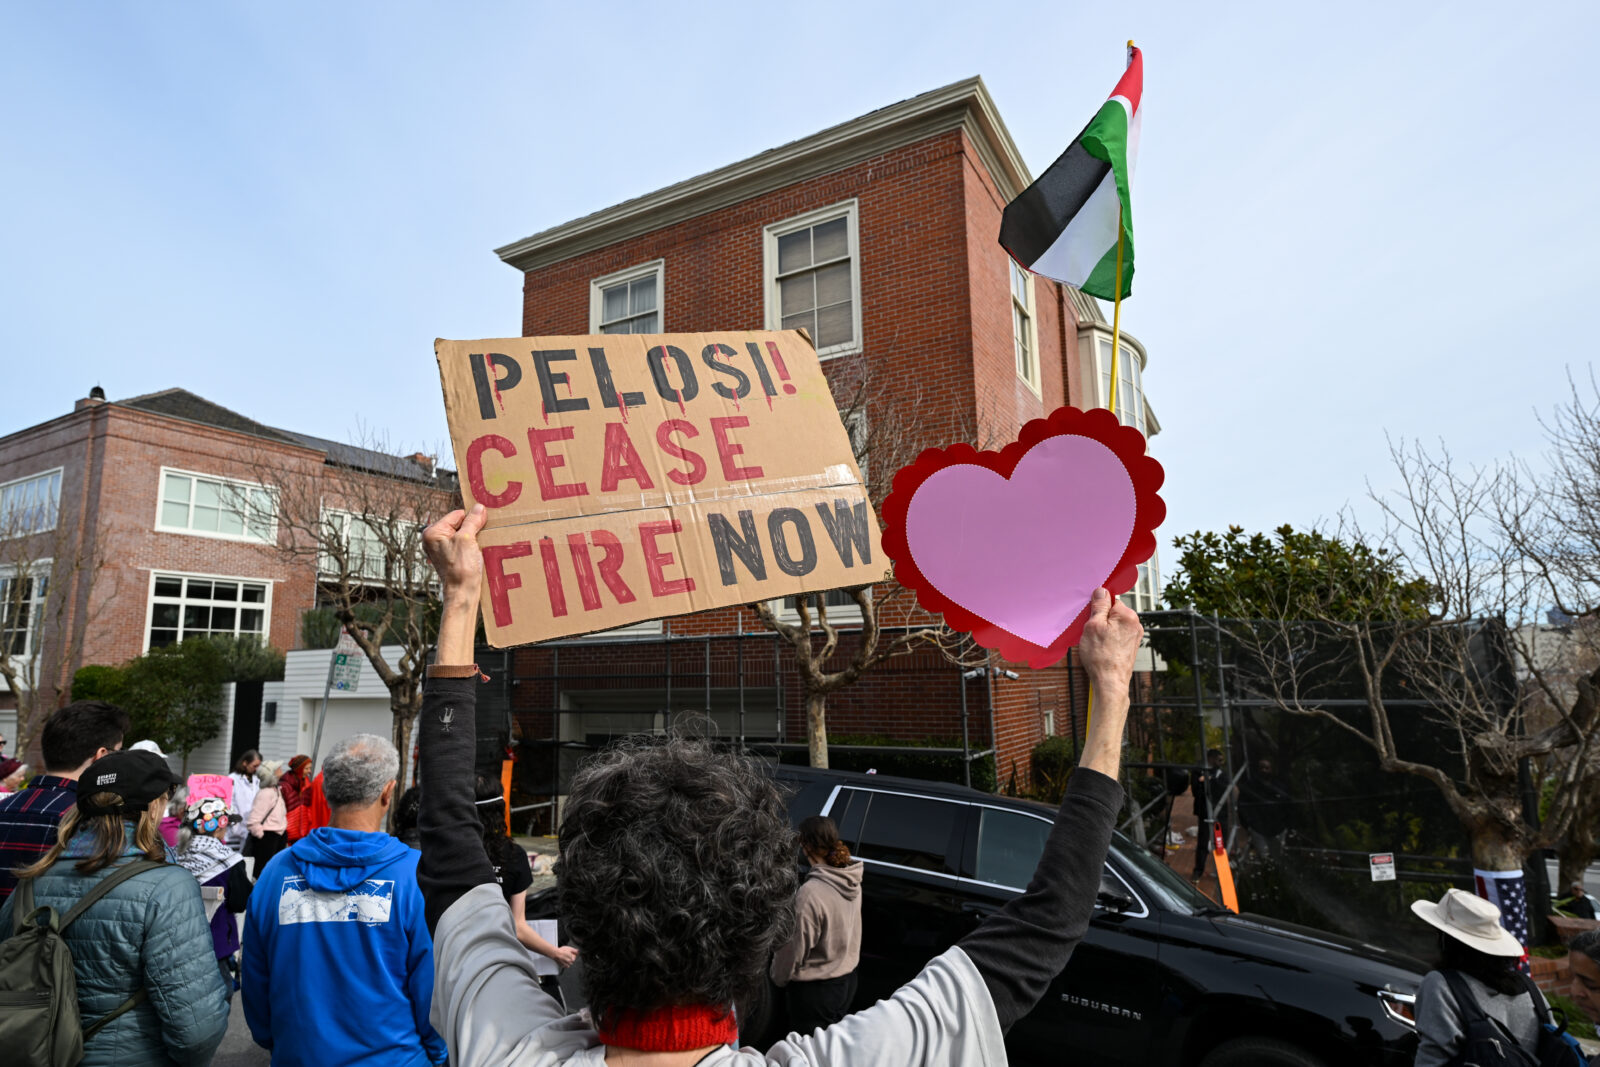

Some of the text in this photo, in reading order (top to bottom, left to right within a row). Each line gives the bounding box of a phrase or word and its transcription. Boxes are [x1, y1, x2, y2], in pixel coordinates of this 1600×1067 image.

[469, 341, 797, 420] PELOSI!
[466, 415, 765, 509] CEASE
[482, 497, 872, 628] FIRE NOW
[1061, 993, 1142, 1021] SUBURBAN
